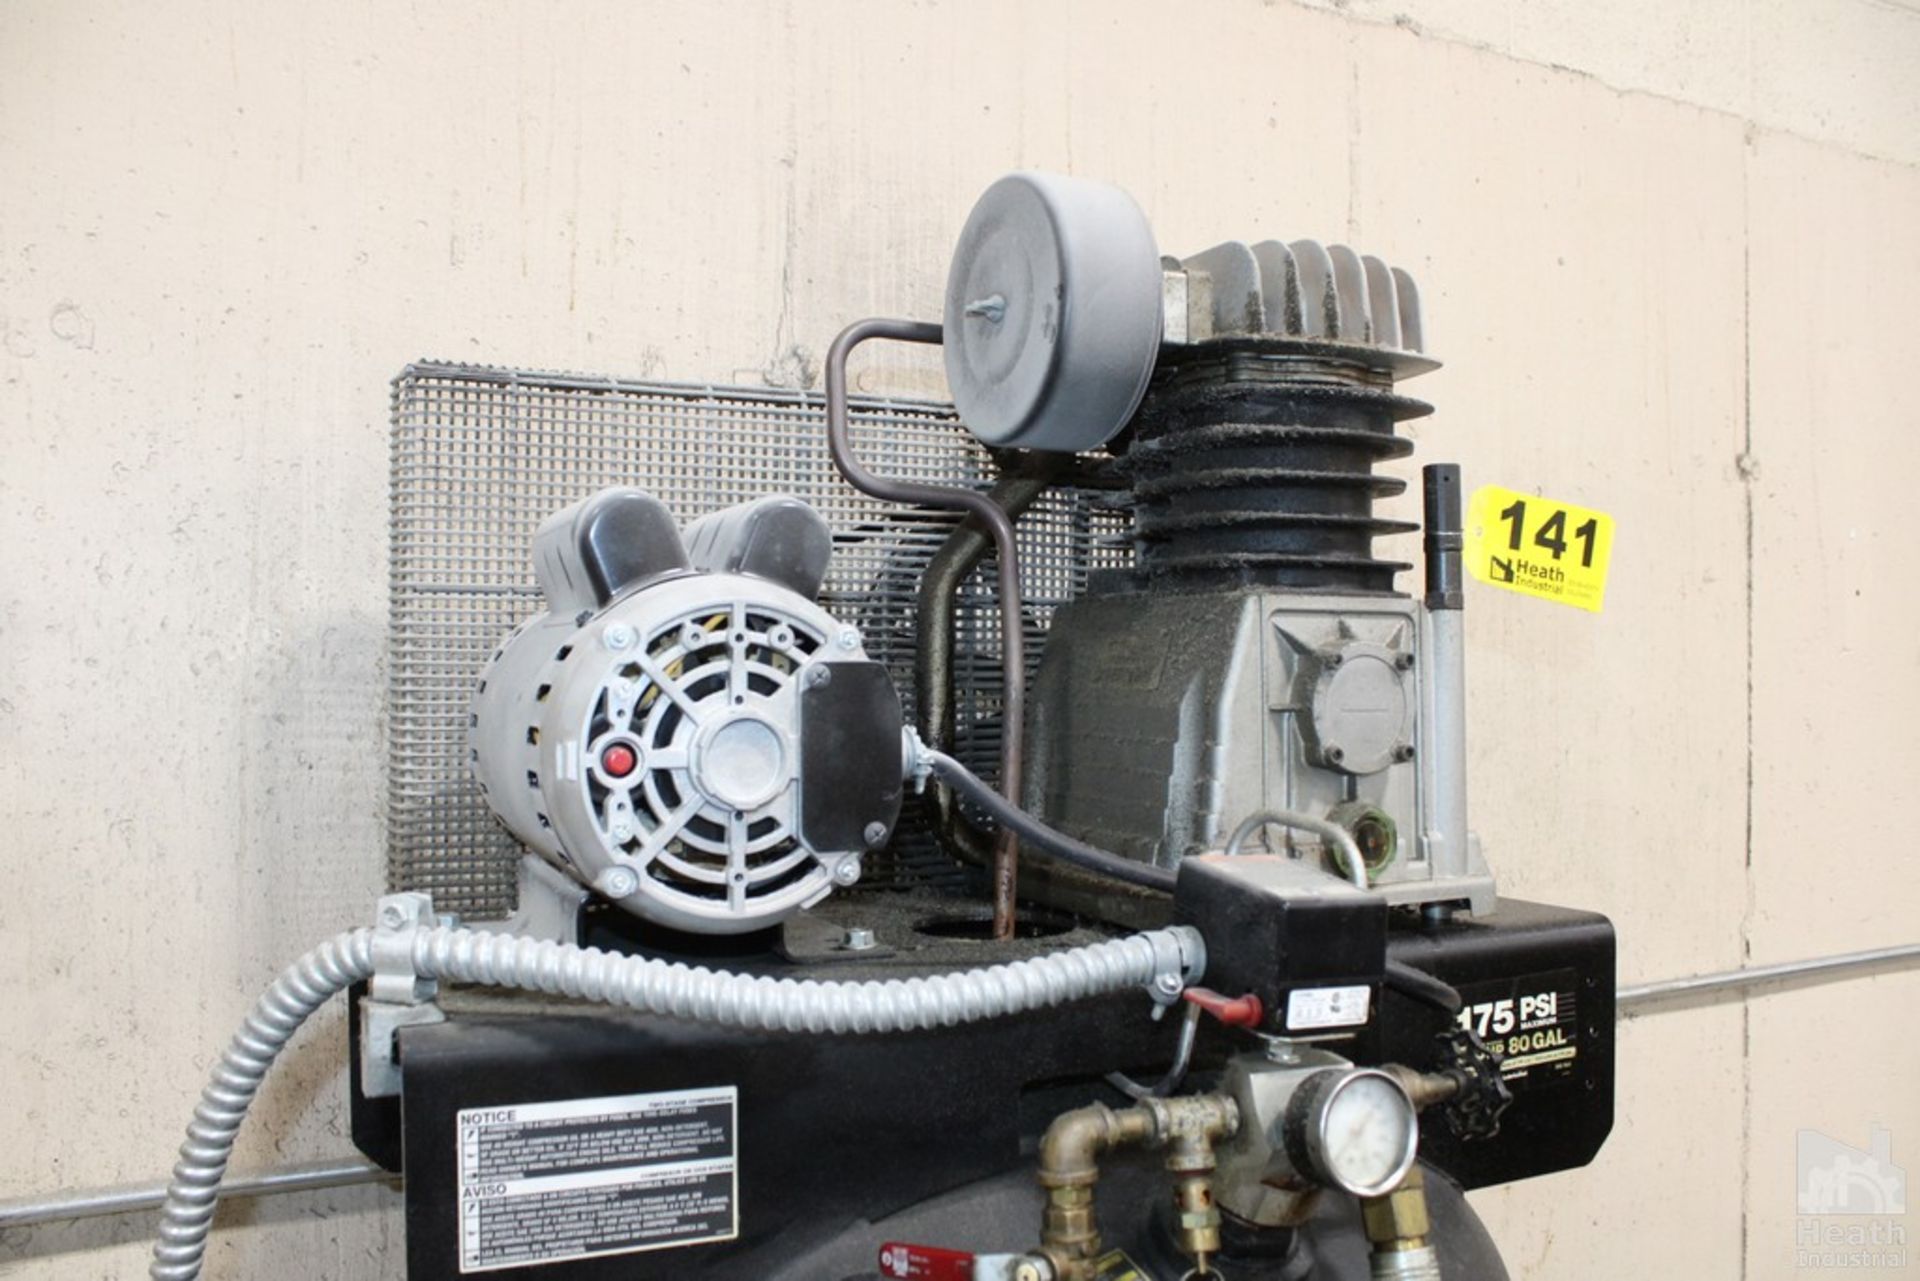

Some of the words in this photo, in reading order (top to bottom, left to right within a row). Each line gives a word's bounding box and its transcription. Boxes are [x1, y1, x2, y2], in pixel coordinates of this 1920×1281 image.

[1500, 499, 1597, 568] 141
[1516, 559, 1565, 582] Heath
[1515, 575, 1564, 595] Industrial
[1456, 999, 1515, 1038] 175
[1520, 991, 1557, 1021] PSI
[1508, 1034, 1530, 1054] 80
[1532, 1027, 1567, 1050] GAL
[460, 1110, 517, 1126] NOTICE
[462, 1183, 507, 1199] AVISO
